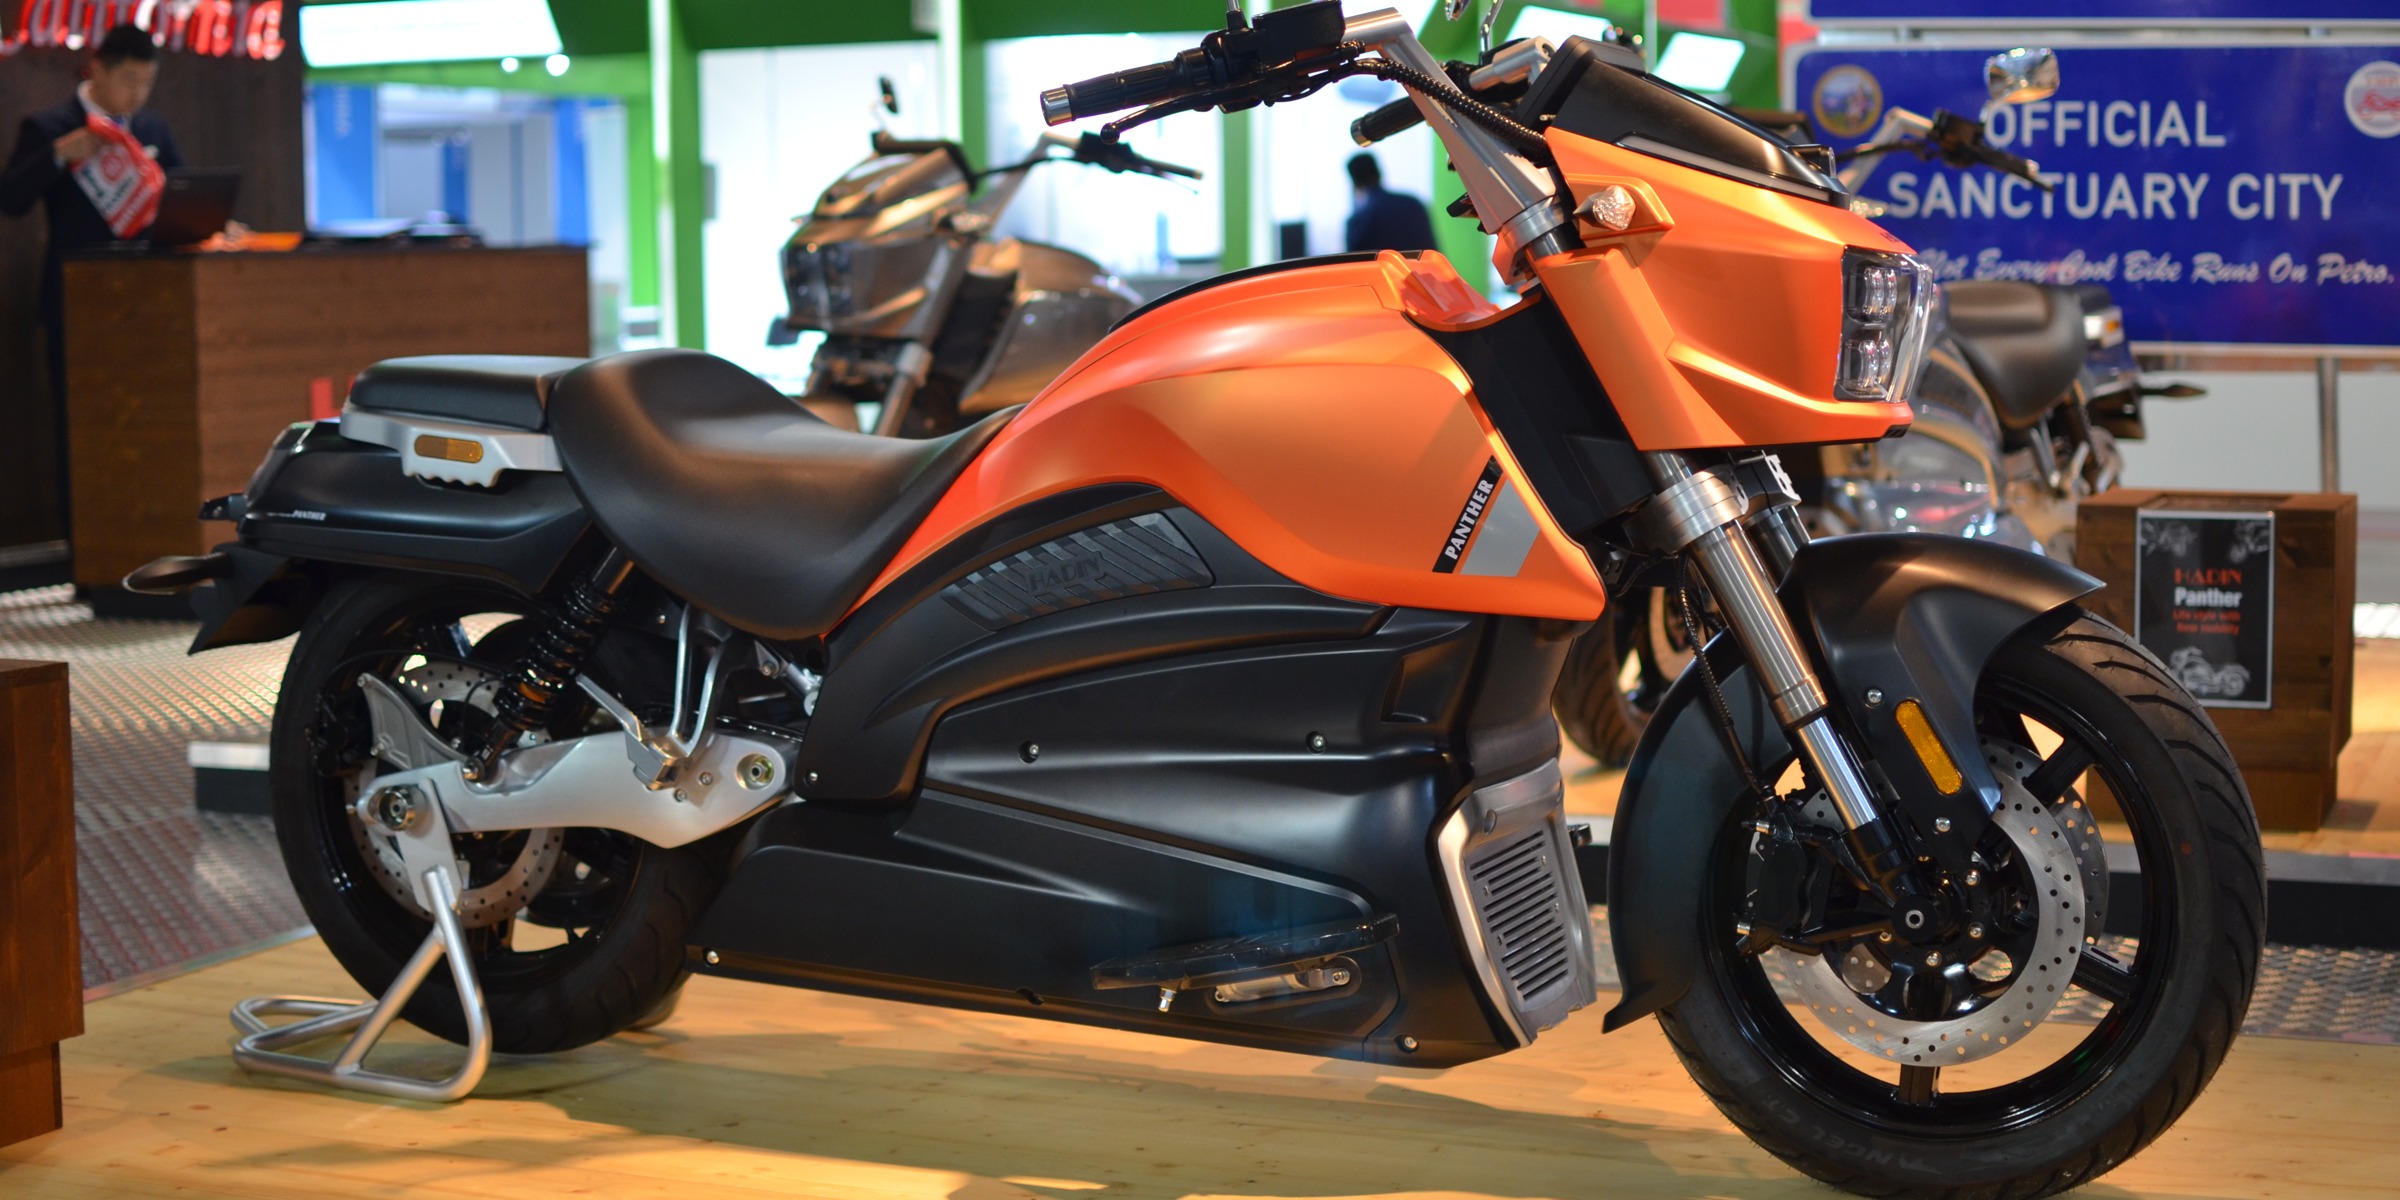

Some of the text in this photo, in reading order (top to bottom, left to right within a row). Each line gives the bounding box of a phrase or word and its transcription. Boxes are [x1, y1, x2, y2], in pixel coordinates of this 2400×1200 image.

[1984, 99, 2226, 148] OFFICIAL
[1887, 172, 2343, 220] SANCTUARY CITY
[1973, 247, 2048, 283] Every
[2056, 248, 2118, 285] Cool
[2123, 249, 2183, 285] Bike
[2191, 252, 2261, 285] Runs
[2268, 251, 2307, 285] On
[1444, 479, 1494, 560] PANTHER
[1029, 556, 1101, 590] HADIN
[2174, 567, 2243, 586] HADIN
[2174, 587, 2243, 608] Panther
